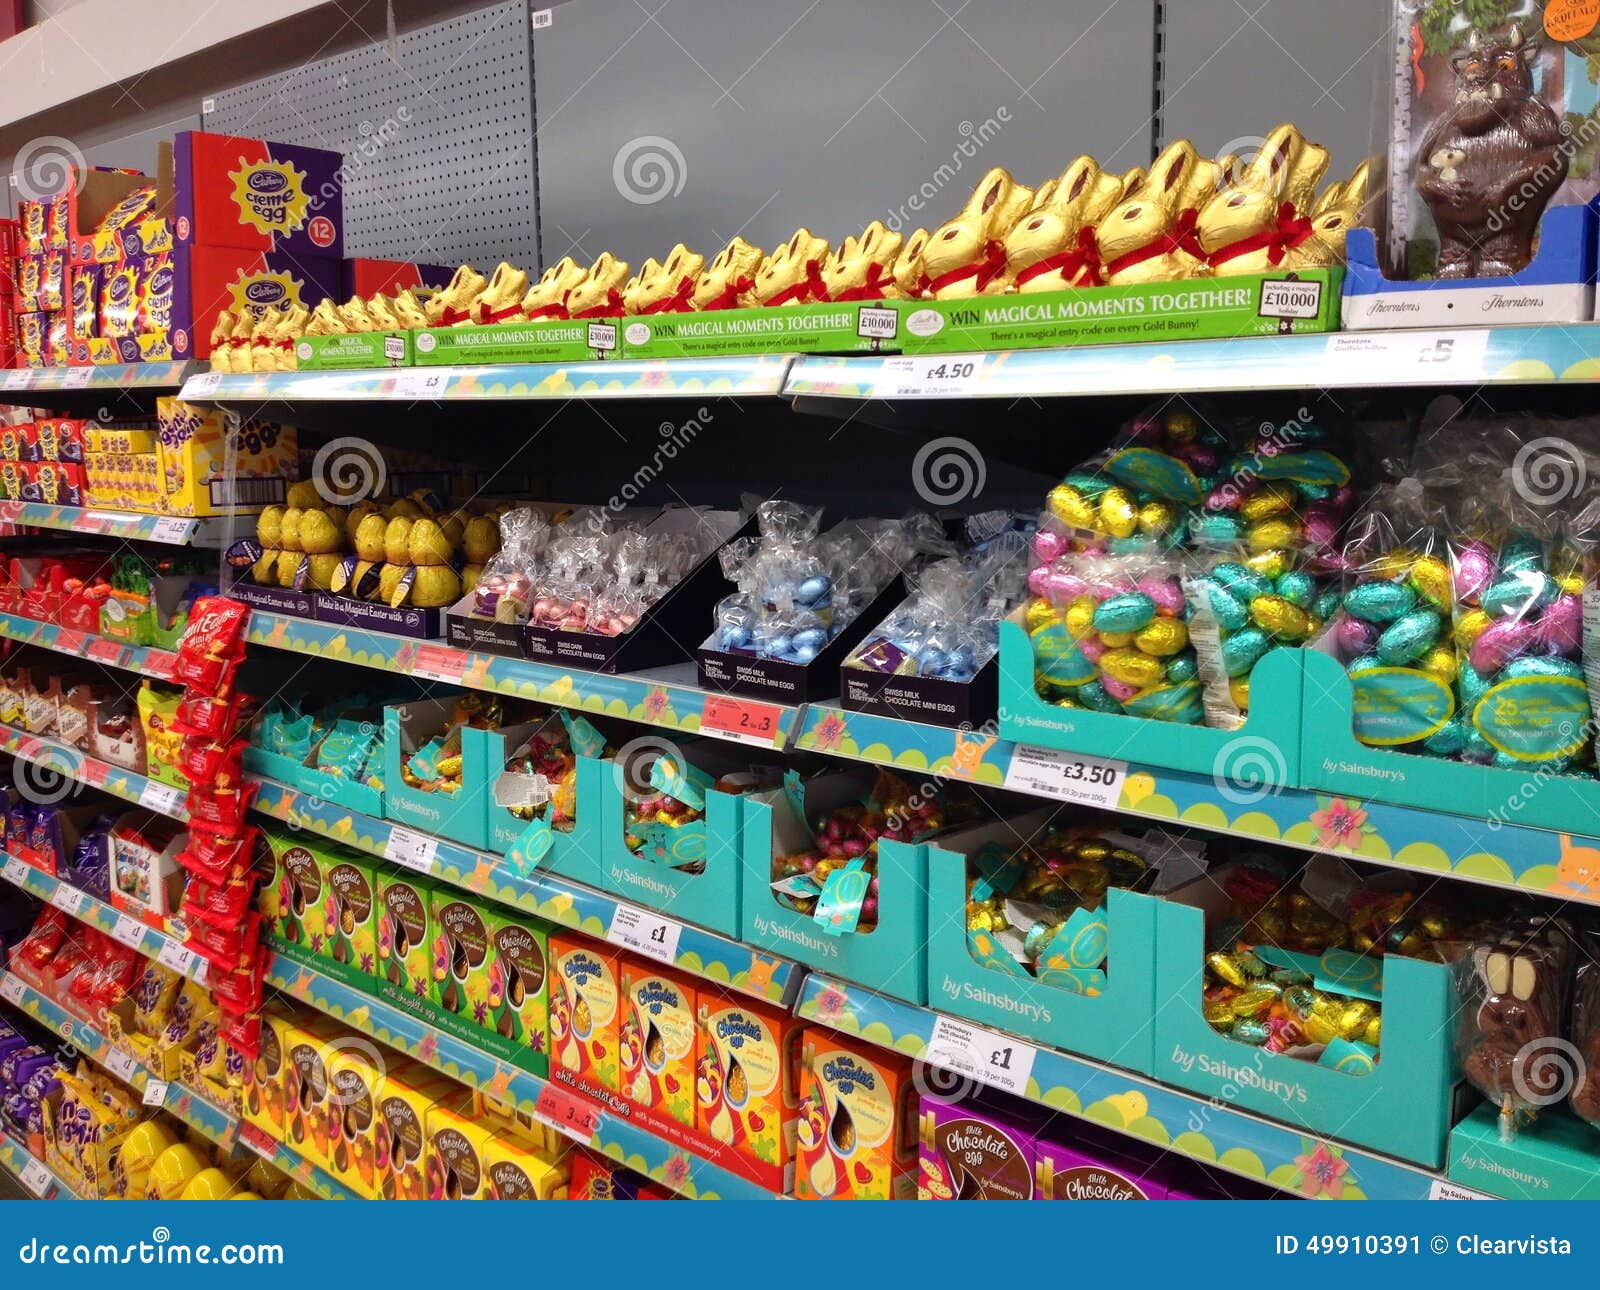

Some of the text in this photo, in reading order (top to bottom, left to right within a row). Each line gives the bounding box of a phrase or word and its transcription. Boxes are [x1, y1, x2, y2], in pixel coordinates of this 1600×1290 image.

[246, 189, 295, 206] creme
[253, 205, 286, 224] egg
[313, 222, 330, 239] 12
[950, 288, 1251, 325] WIN MAGICAL MOMENTS TOGETHER!
[1367, 300, 1420, 316] Thorntons
[1482, 294, 1544, 312] Thorntons
[655, 314, 853, 337] WIN MAGICAL MOMENTS TOGETHER!
[991, 332, 1018, 341] There's
[1026, 329, 1057, 340] magical
[1058, 328, 1079, 339] entry
[1081, 326, 1102, 336] code
[1104, 326, 1115, 334] on
[1116, 323, 1141, 334] every
[1143, 320, 1165, 331] Gold
[1167, 319, 1199, 331] Bunny!
[439, 329, 584, 345] WIN MAGICAL MOMENTS TOGETHER!
[927, 363, 974, 379] £4.50
[318, 598, 403, 622] Make Magical Easter with
[737, 666, 765, 677] SWISS MILK
[737, 674, 795, 690] CHOCOLATE MINI EGGS
[885, 688, 920, 699] SWISS MILK
[884, 697, 956, 713] CHOCOLATE MINI EGGS
[741, 713, 770, 730] 2 £3
[1014, 714, 1075, 733] by Sainsbury's
[1064, 763, 1116, 785] £3.50
[1322, 758, 1406, 782] by Sainsbury's
[611, 864, 677, 898] by Sainsbury's
[651, 926, 667, 943] £1
[754, 913, 838, 958] by Sainsbury's
[942, 975, 1052, 1023] by Sainsbury's
[716, 1017, 762, 1042] Chocolate
[990, 1047, 1013, 1070] £1
[822, 1060, 875, 1090] Chocolate
[1171, 1044, 1309, 1103] by Sainsbury's
[555, 1071, 576, 1087] white
[577, 1080, 614, 1106] chocolate
[965, 1125, 983, 1136] Milk
[946, 1130, 1008, 1159] Chocolate
[965, 1151, 983, 1166] egg
[1087, 1173, 1107, 1185] Milk
[1461, 1152, 1549, 1189] by Sainsbury's
[980, 1177, 1024, 1200] by Sainsbury's
[1440, 1187, 1450, 1197] by
